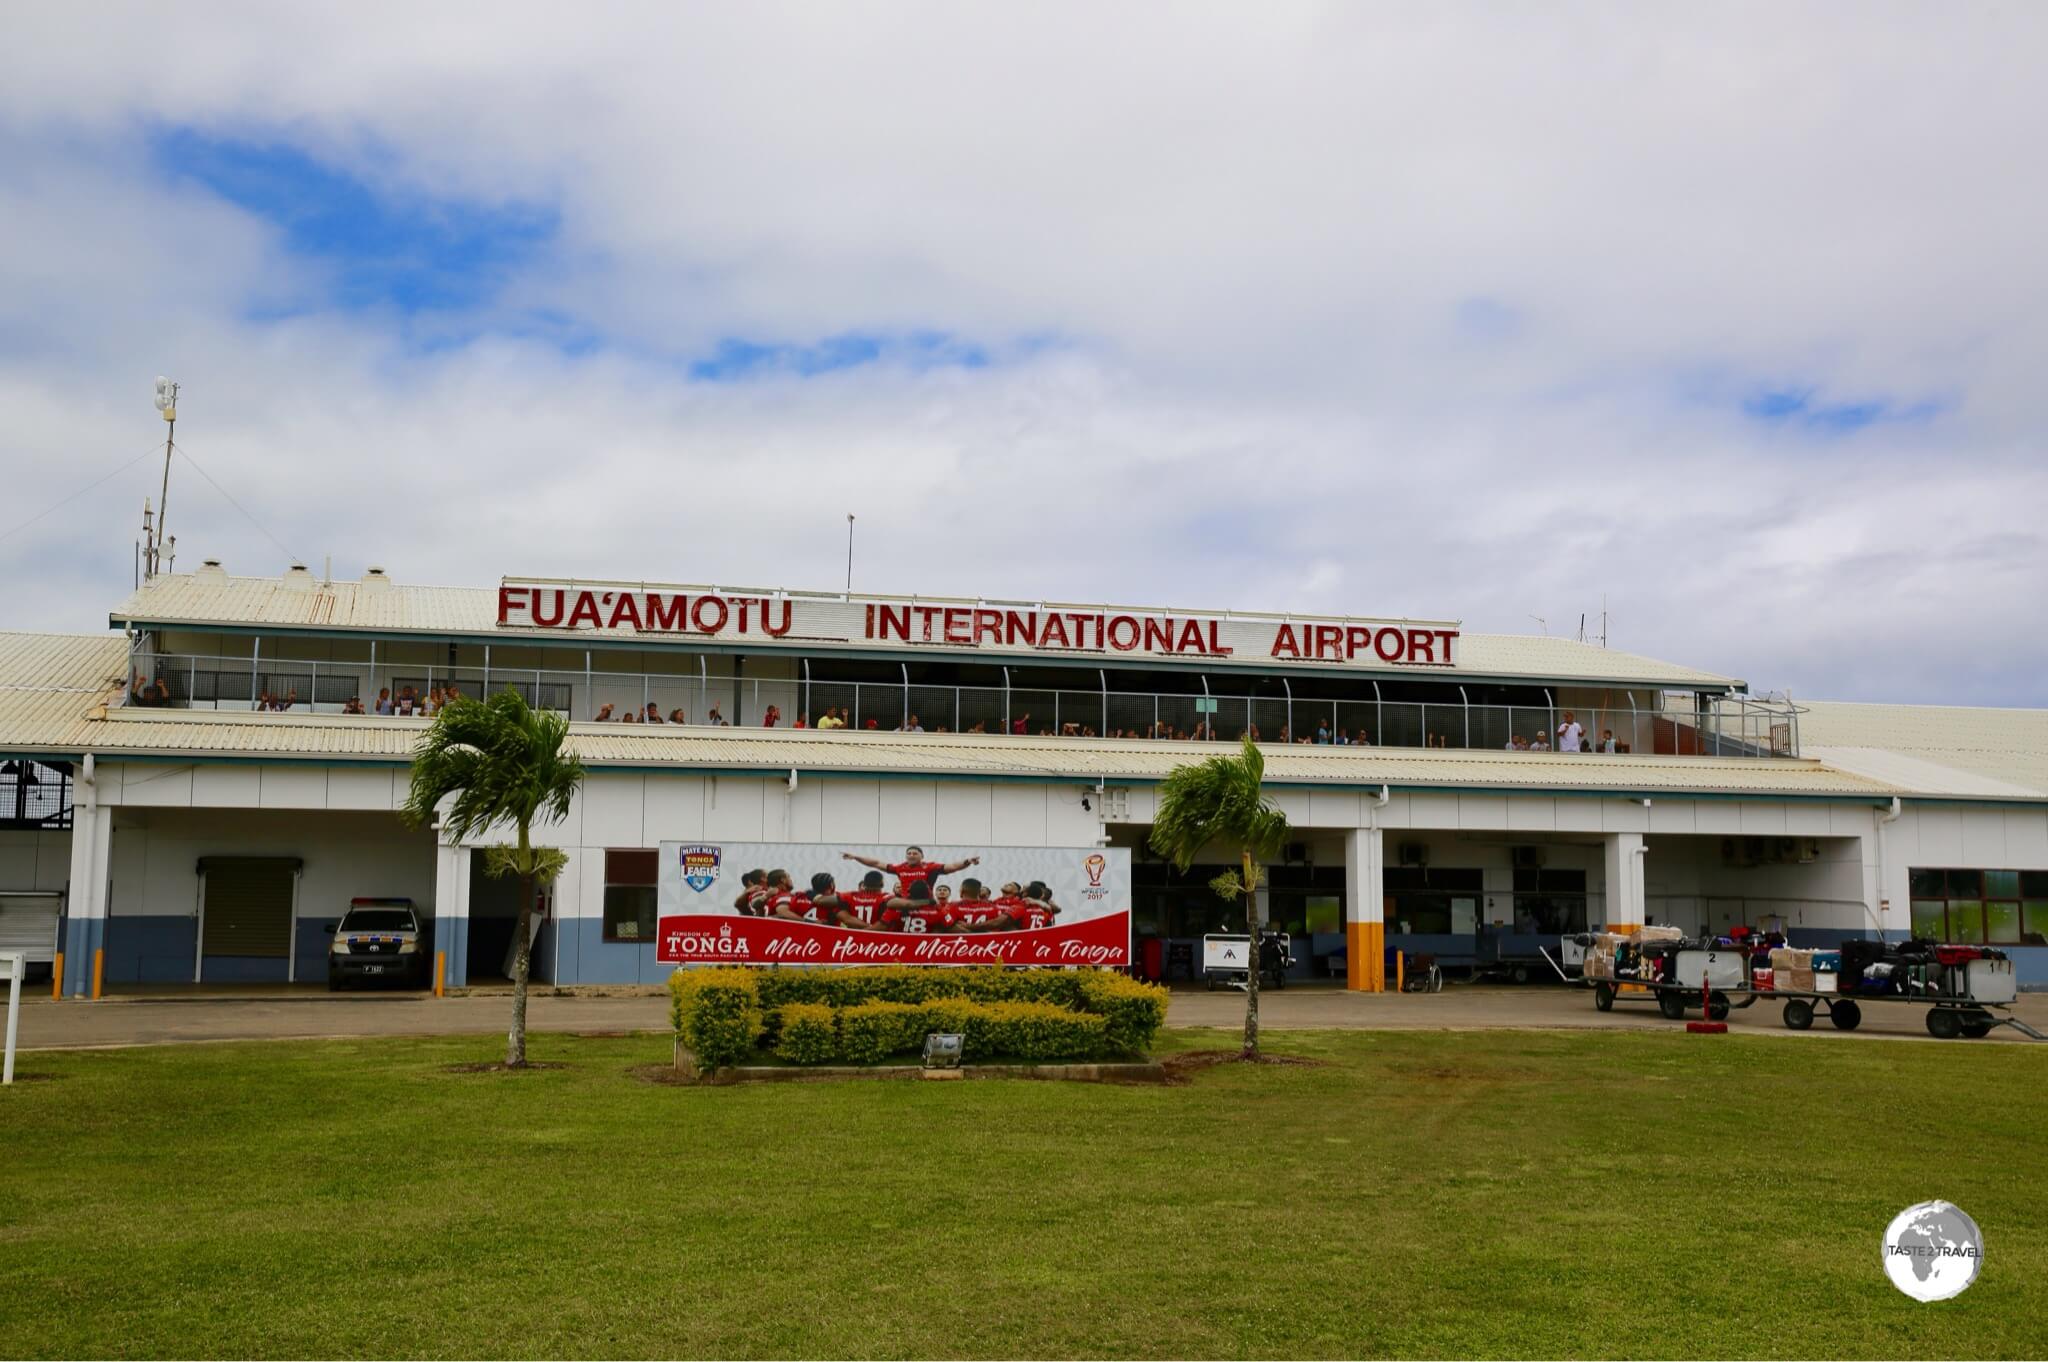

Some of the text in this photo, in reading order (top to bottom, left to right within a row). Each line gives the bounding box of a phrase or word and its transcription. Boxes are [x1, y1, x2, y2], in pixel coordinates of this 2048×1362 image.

[864, 603, 1234, 655] INTERNATIONAL
[1270, 623, 1460, 663] AIRPORT
[686, 856, 715, 864] TONGA
[680, 865, 720, 879] LEAGUE
[854, 905, 873, 925] 11
[901, 916, 927, 933] 18
[666, 937, 750, 954] TONGA
[764, 936, 822, 959] Malo
[1059, 939, 1123, 964] Tonga
[1708, 952, 1716, 963] 2
